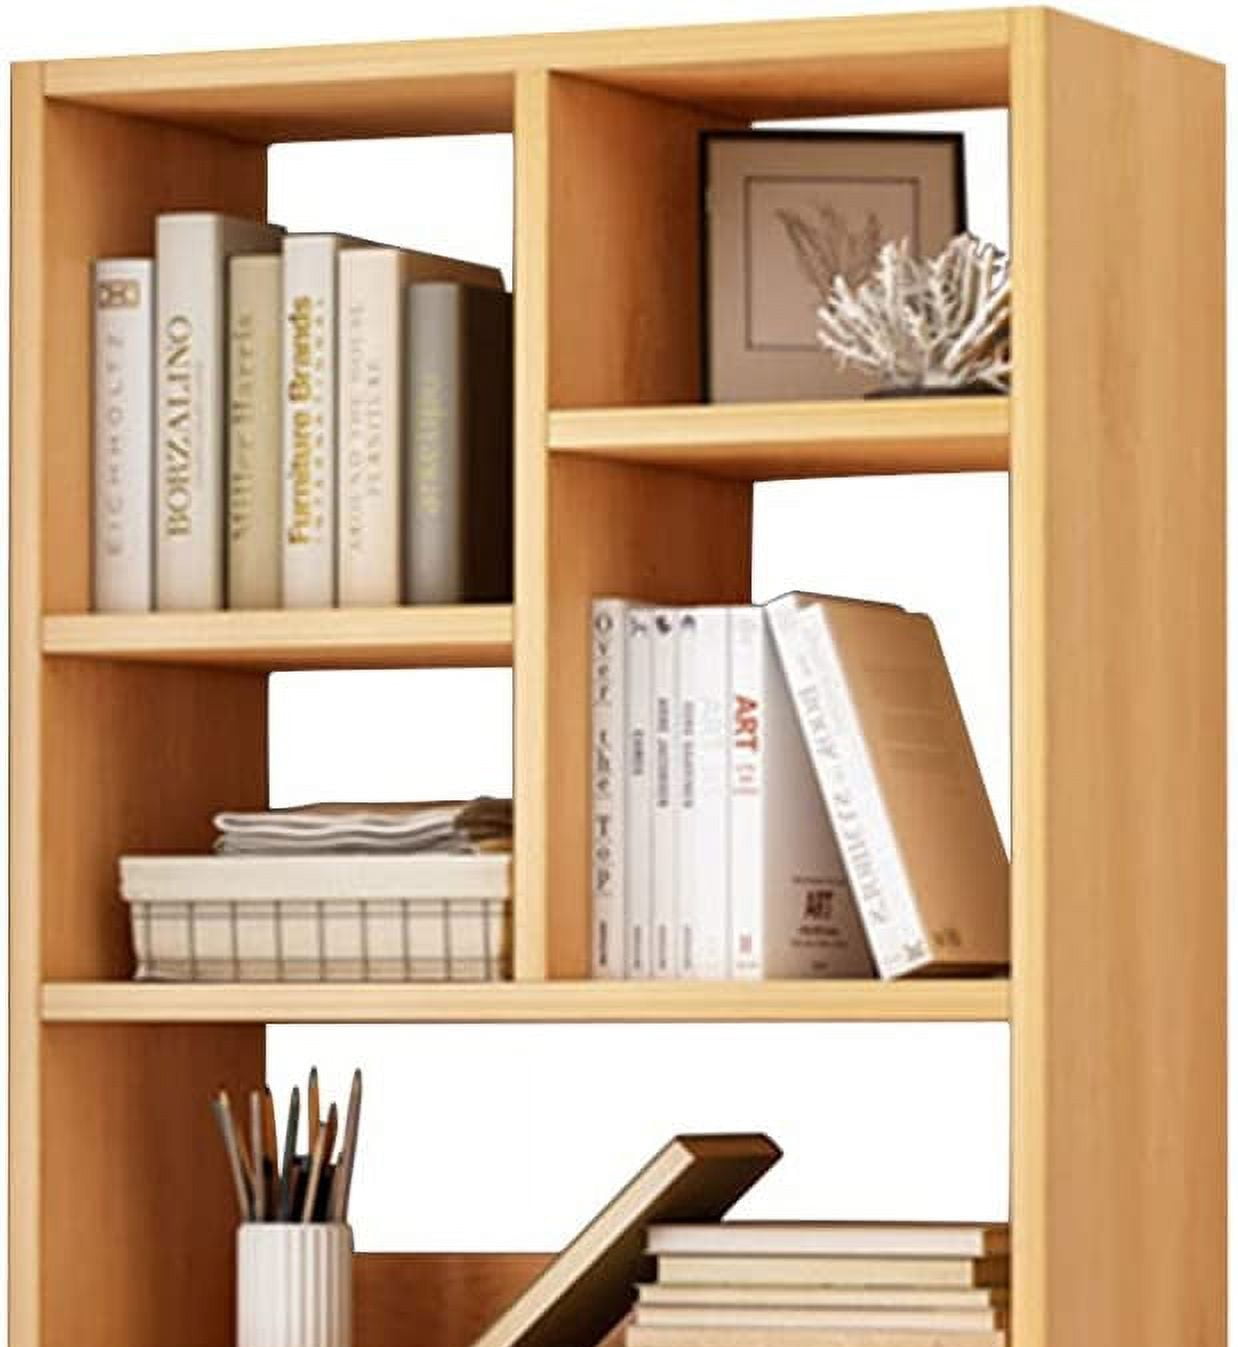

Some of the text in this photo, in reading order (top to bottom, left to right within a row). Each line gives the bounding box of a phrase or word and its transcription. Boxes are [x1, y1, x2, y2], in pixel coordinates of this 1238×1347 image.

[166, 314, 192, 537] BORZALINO
[288, 296, 312, 545] Furniture Brands
[735, 695, 758, 752] ART
